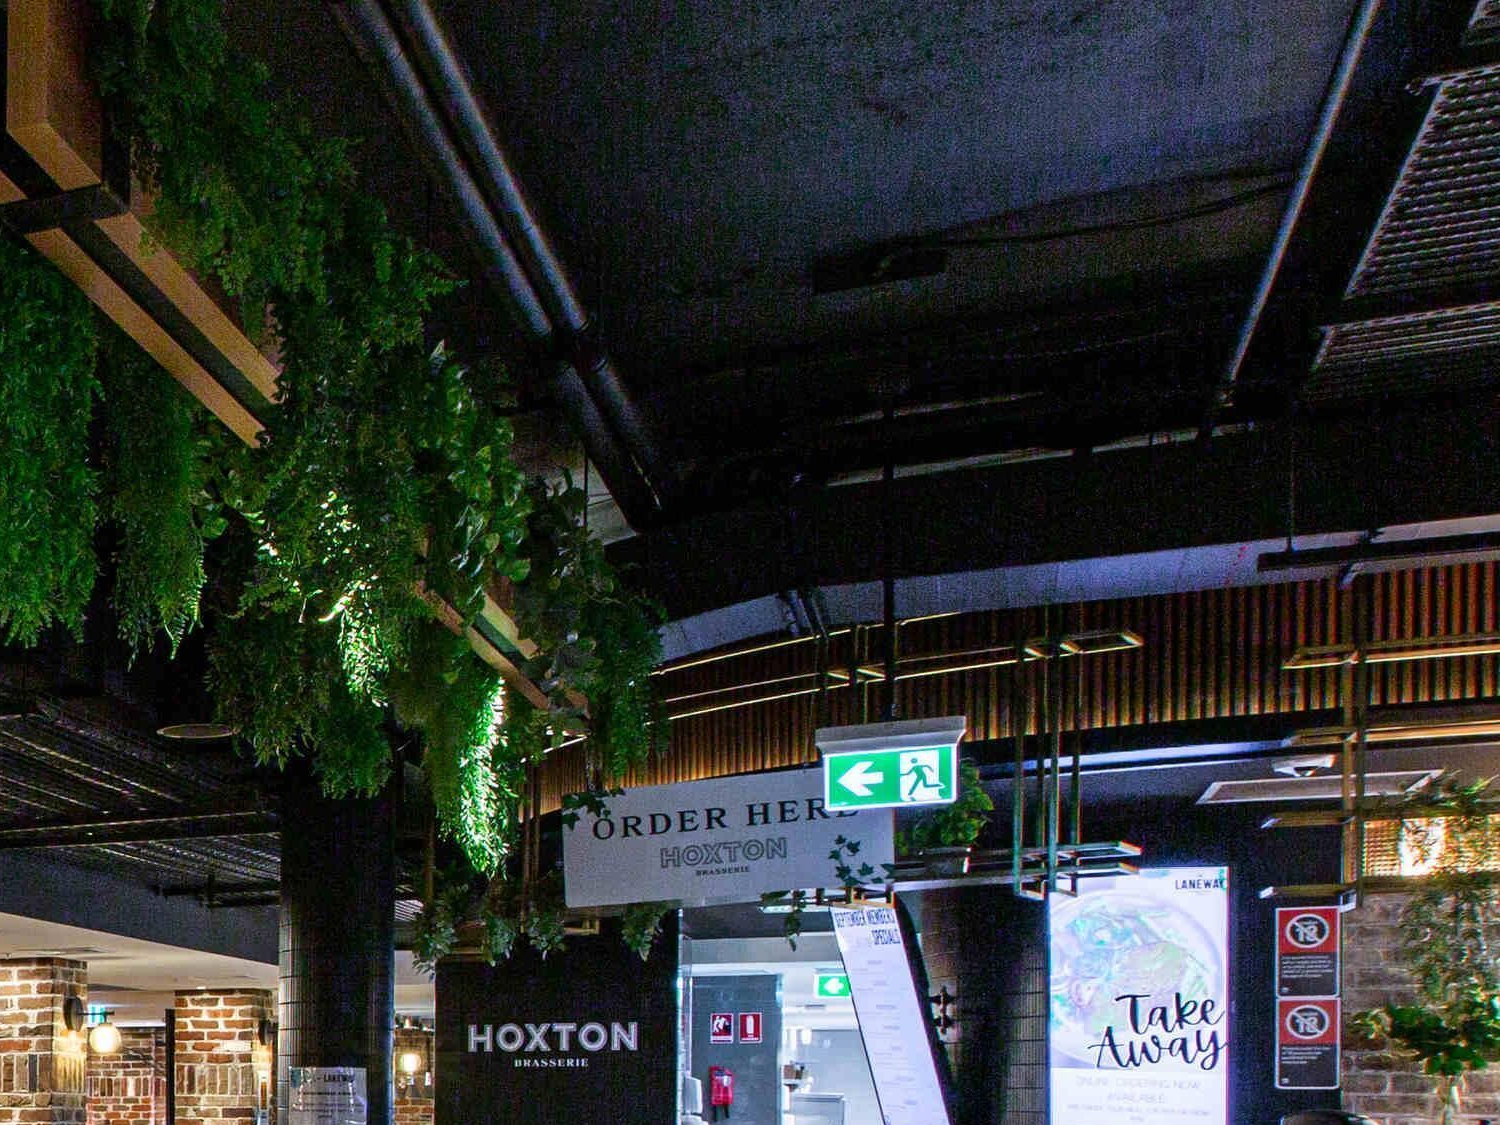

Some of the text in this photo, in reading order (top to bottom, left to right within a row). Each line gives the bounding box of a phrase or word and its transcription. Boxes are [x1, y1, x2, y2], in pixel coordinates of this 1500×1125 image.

[593, 807, 729, 841] ORDER
[660, 837, 789, 869] HOXTON
[695, 866, 751, 877] BRASSERIE
[1114, 991, 1226, 1036] Take
[467, 1022, 639, 1053] HOXTON
[1087, 1026, 1228, 1071] Away
[514, 1057, 589, 1068] BRASSERIE
